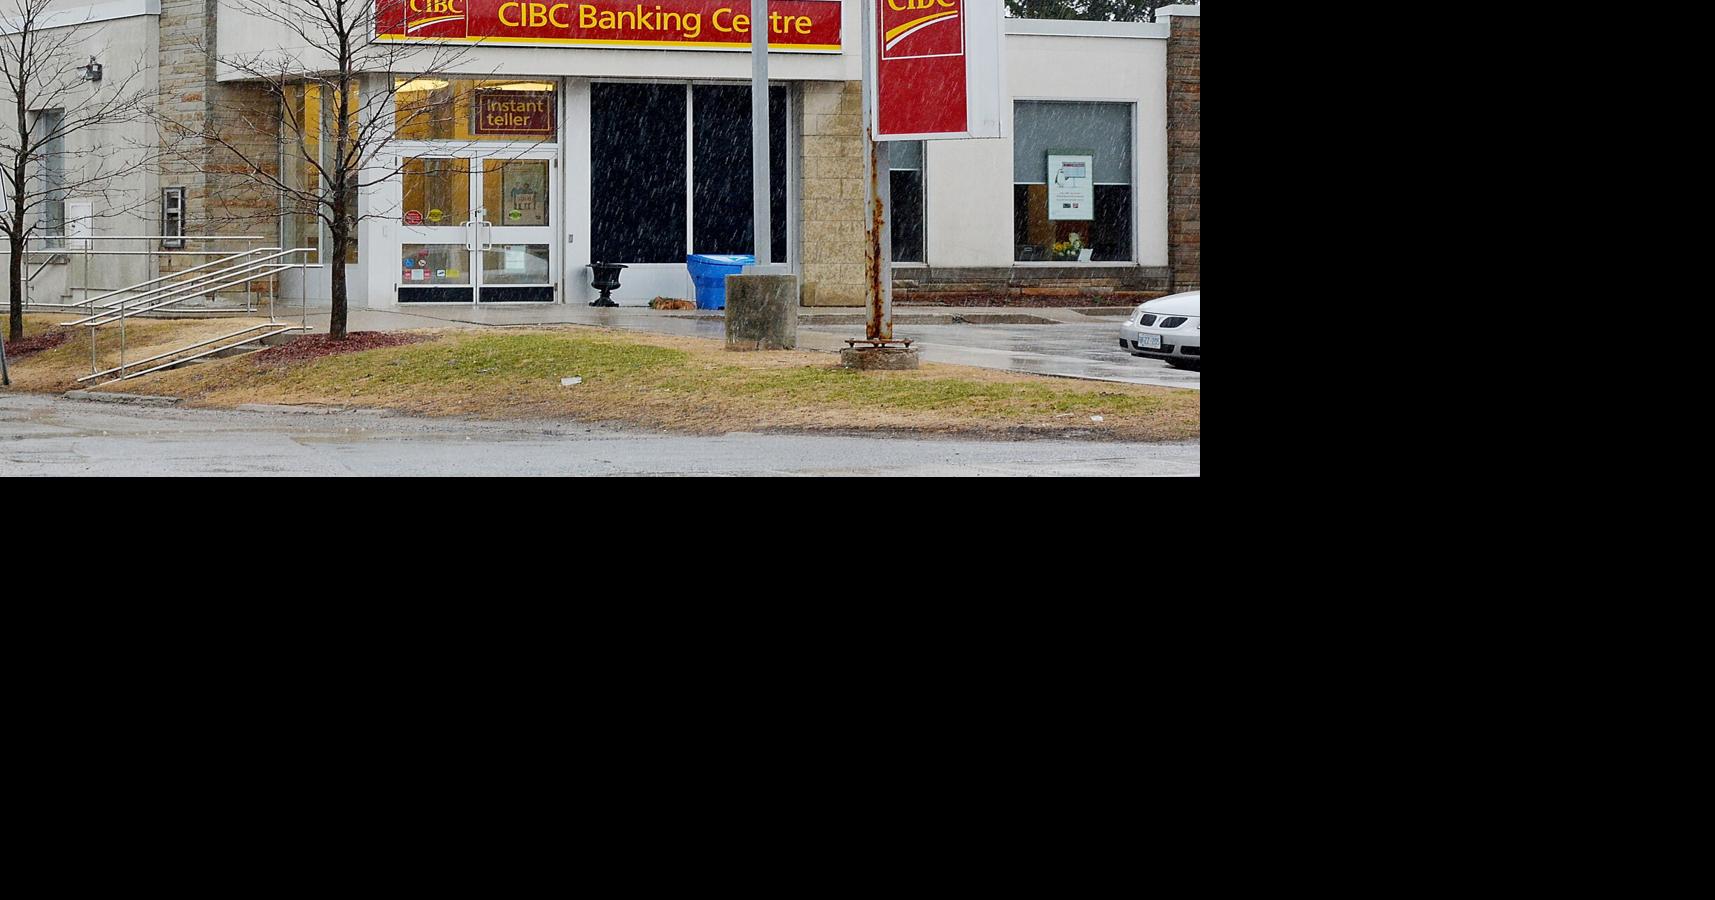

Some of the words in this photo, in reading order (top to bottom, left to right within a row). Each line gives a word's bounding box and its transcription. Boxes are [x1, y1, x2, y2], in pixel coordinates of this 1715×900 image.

[498, 2, 569, 28] CIBC
[579, 4, 701, 38] Banking
[712, 7, 812, 34] Cetre
[487, 99, 544, 112] Instant
[486, 112, 530, 126] teller
